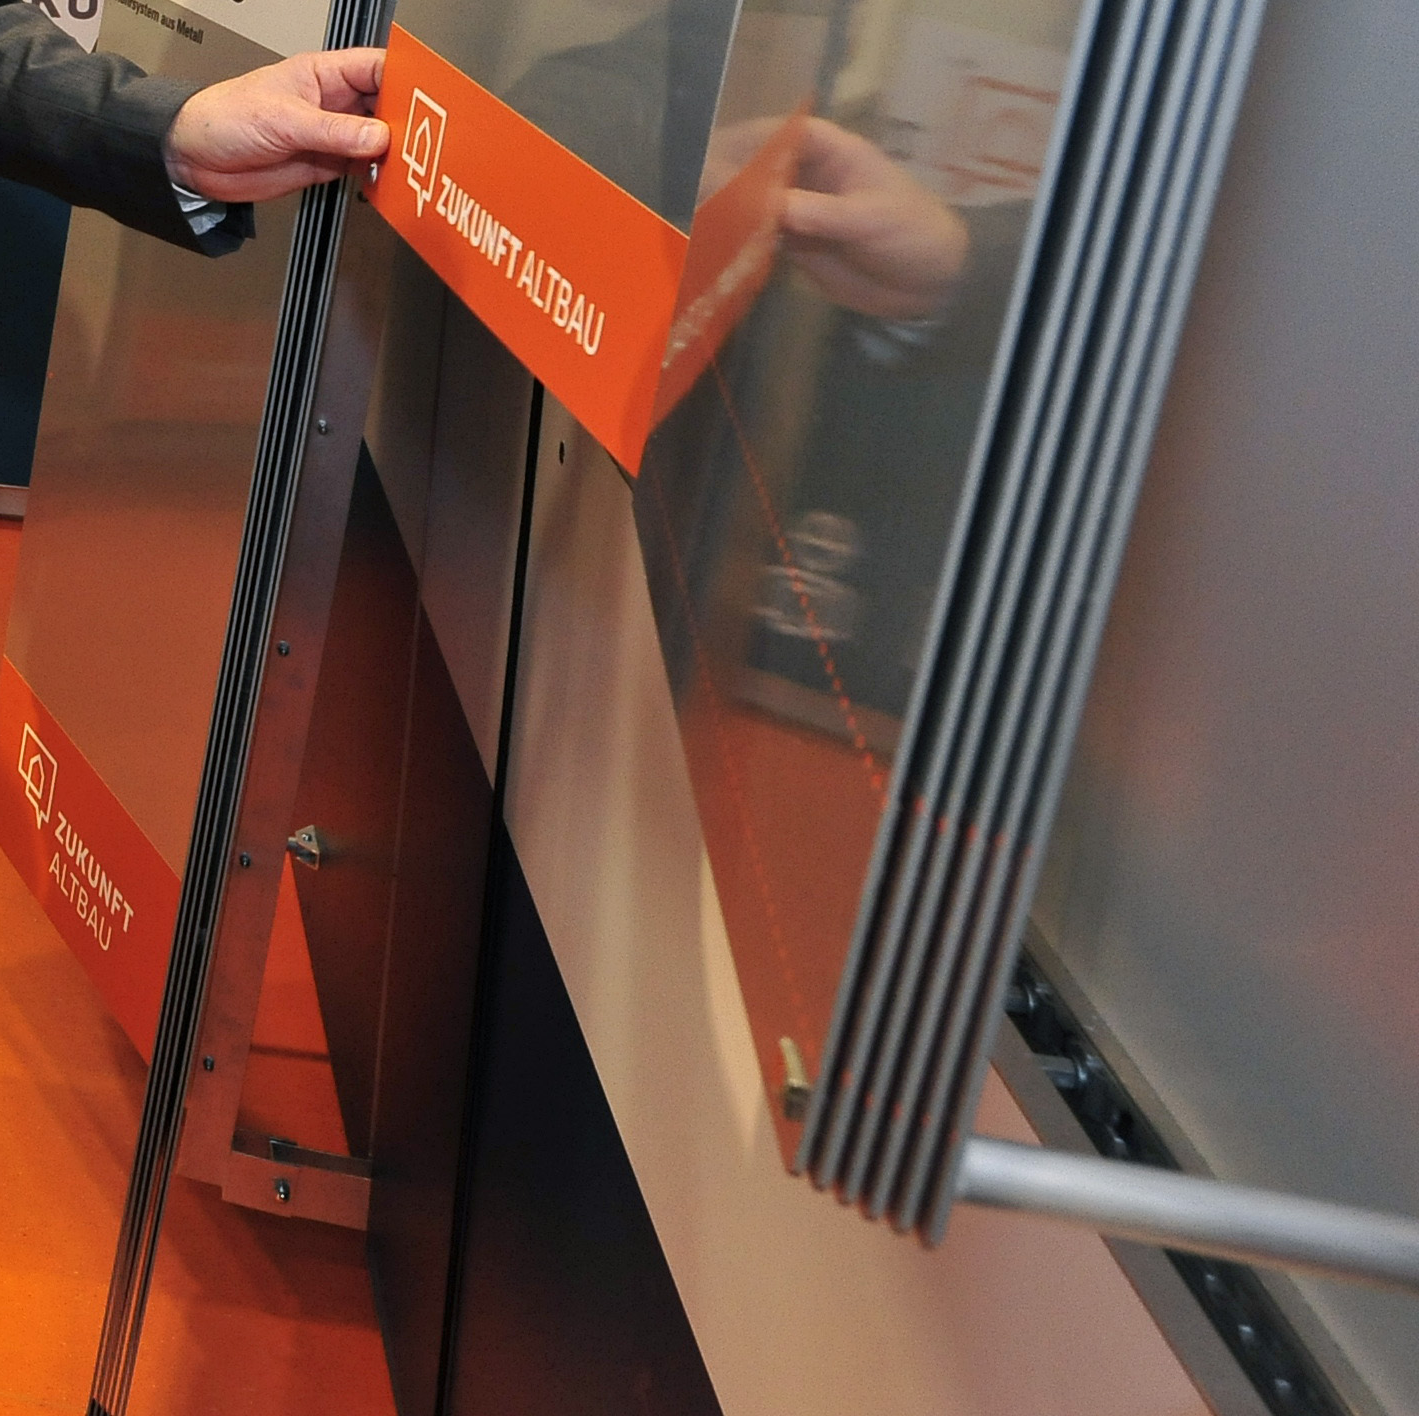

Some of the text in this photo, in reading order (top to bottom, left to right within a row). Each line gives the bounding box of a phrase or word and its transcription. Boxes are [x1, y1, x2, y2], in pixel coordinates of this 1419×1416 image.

[160, 14, 176, 31] aus
[176, 18, 204, 45] Metall
[435, 174, 605, 356] ZUKUNFT ALTBAU
[49, 852, 112, 951] ALTBAU
[54, 811, 134, 933] ZUKUNFT
